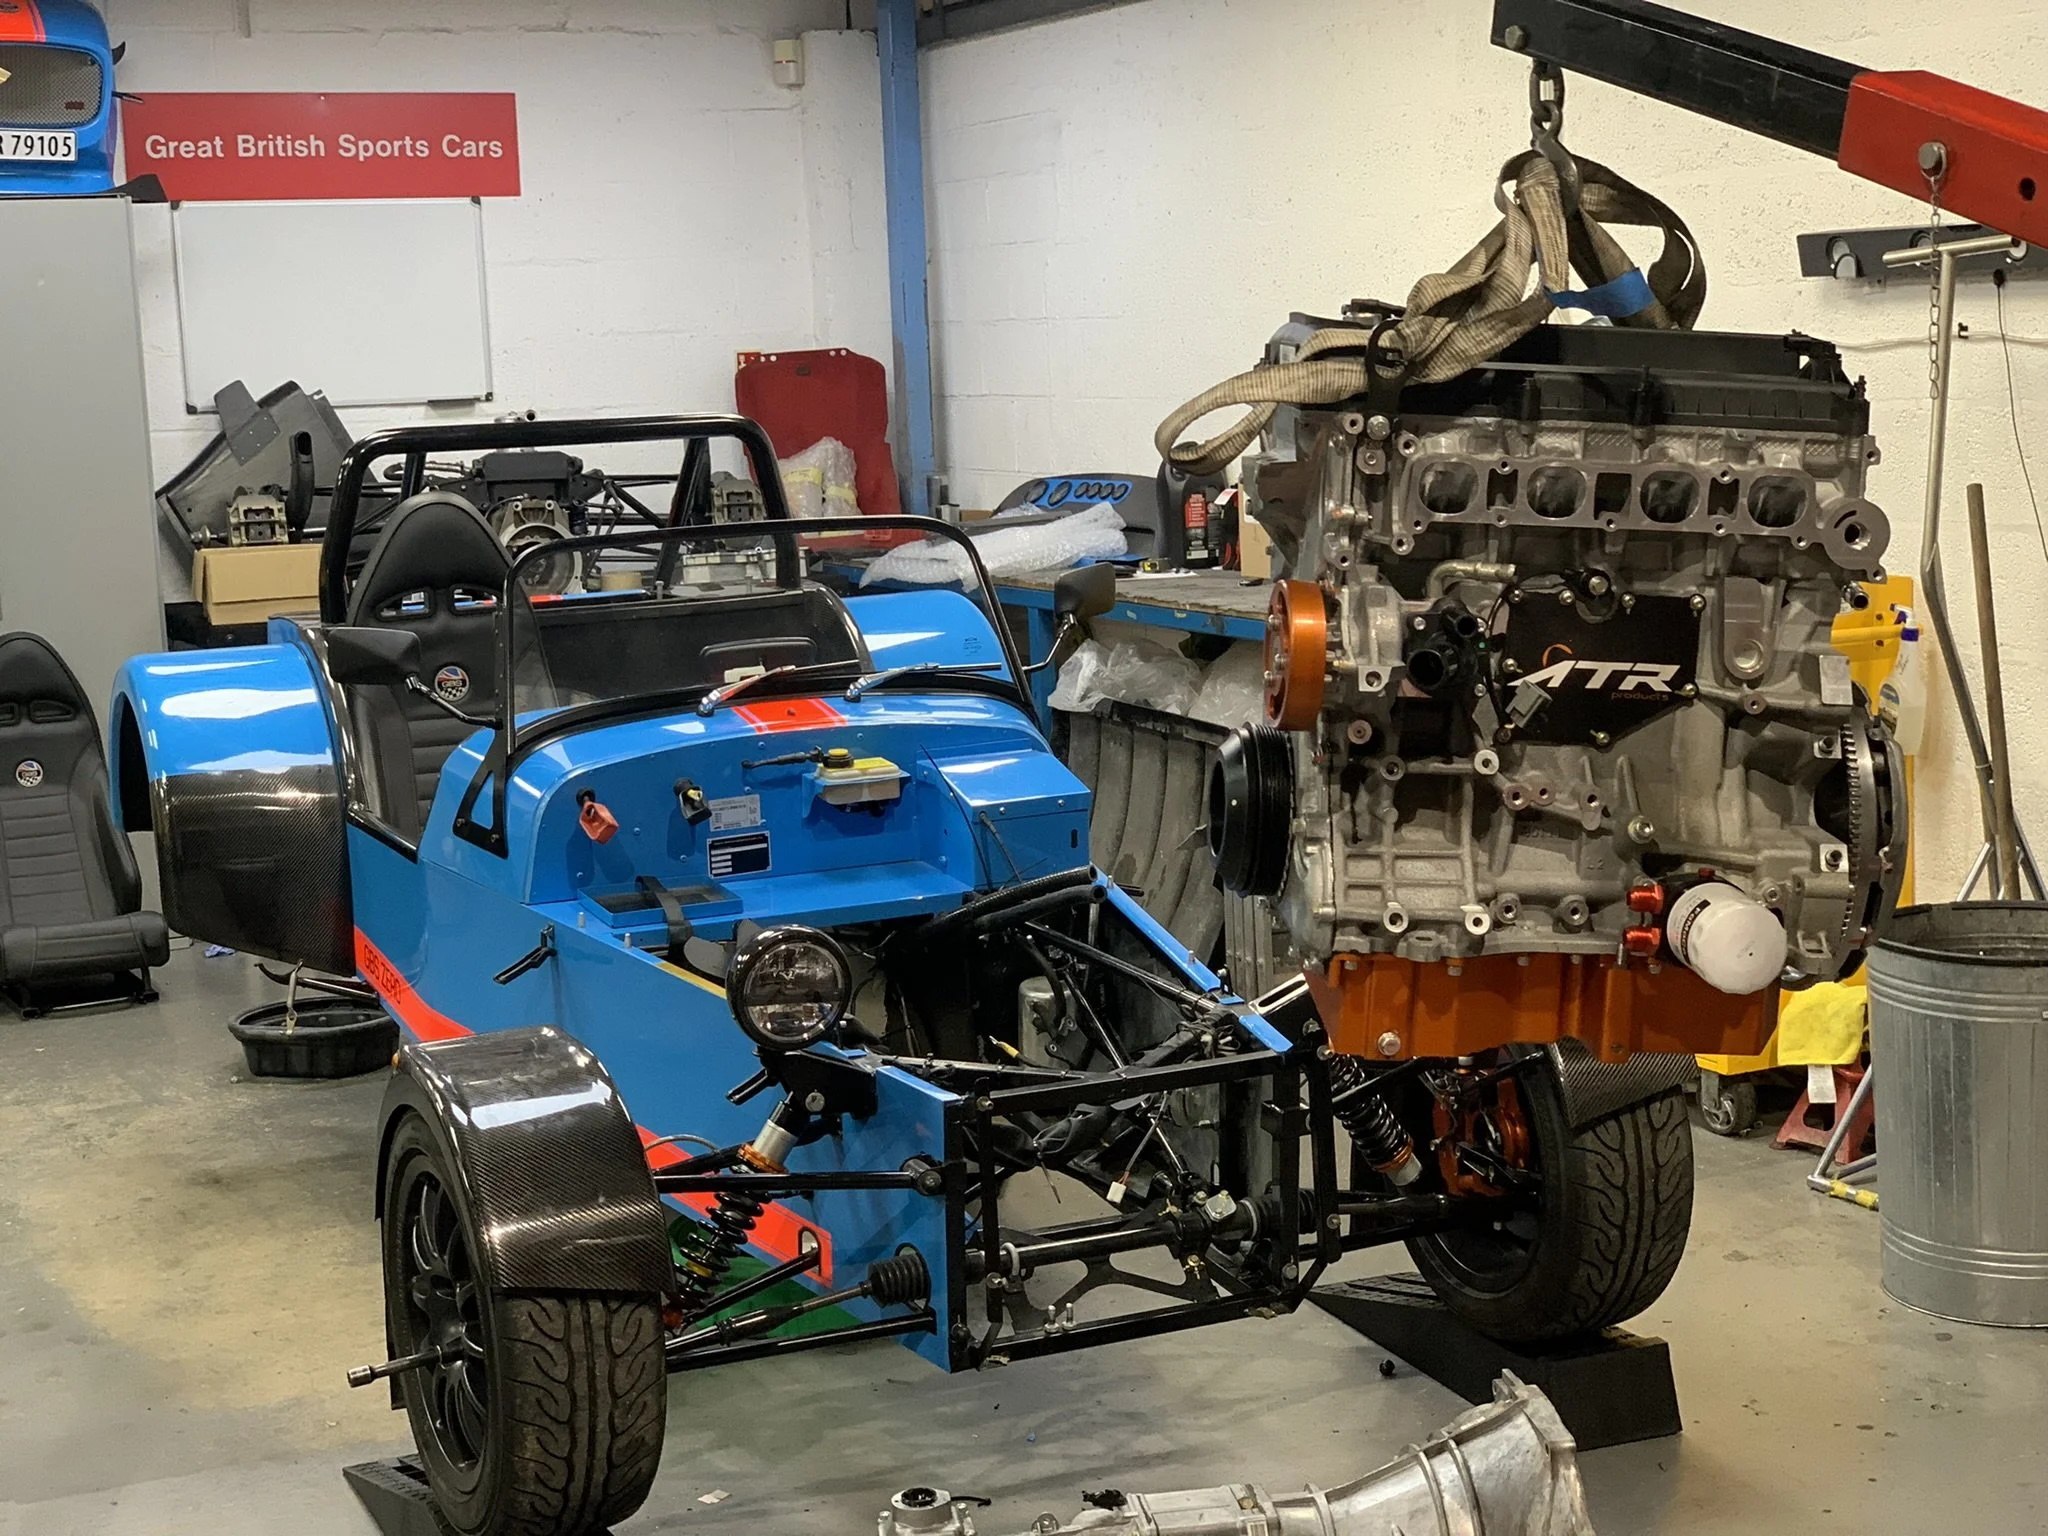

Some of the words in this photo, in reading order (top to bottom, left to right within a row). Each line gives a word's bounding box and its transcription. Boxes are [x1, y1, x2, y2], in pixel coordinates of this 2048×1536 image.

[11, 134, 72, 157] 79105
[145, 134, 225, 159] Great
[237, 134, 326, 158] British
[338, 133, 430, 162] Sports
[442, 134, 503, 158] Cars
[1507, 660, 1681, 692] ATR
[1611, 691, 1669, 701] products
[364, 944, 380, 981] GBS
